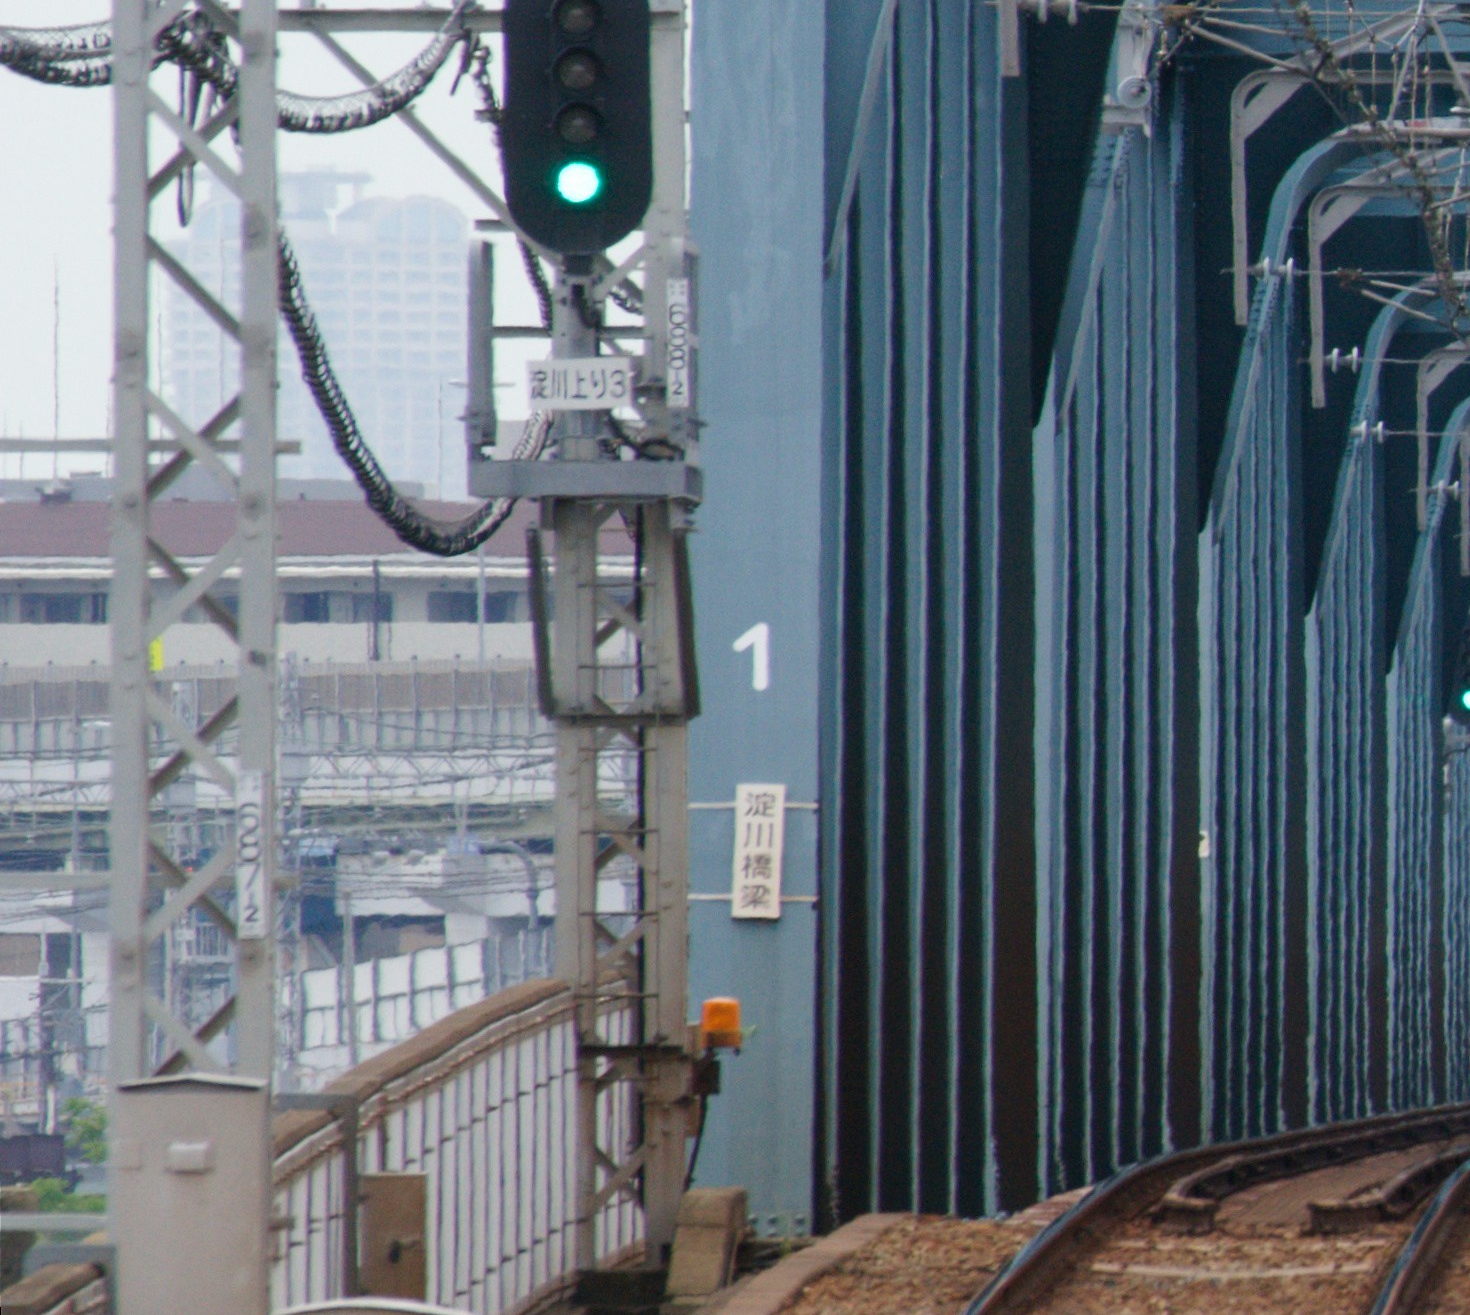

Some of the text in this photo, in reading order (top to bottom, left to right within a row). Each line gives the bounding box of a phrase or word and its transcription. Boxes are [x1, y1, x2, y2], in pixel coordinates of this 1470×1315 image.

[530, 368, 626, 400] 淀川上り3
[732, 622, 770, 691] 1
[741, 790, 777, 912] 淀川橋梁
